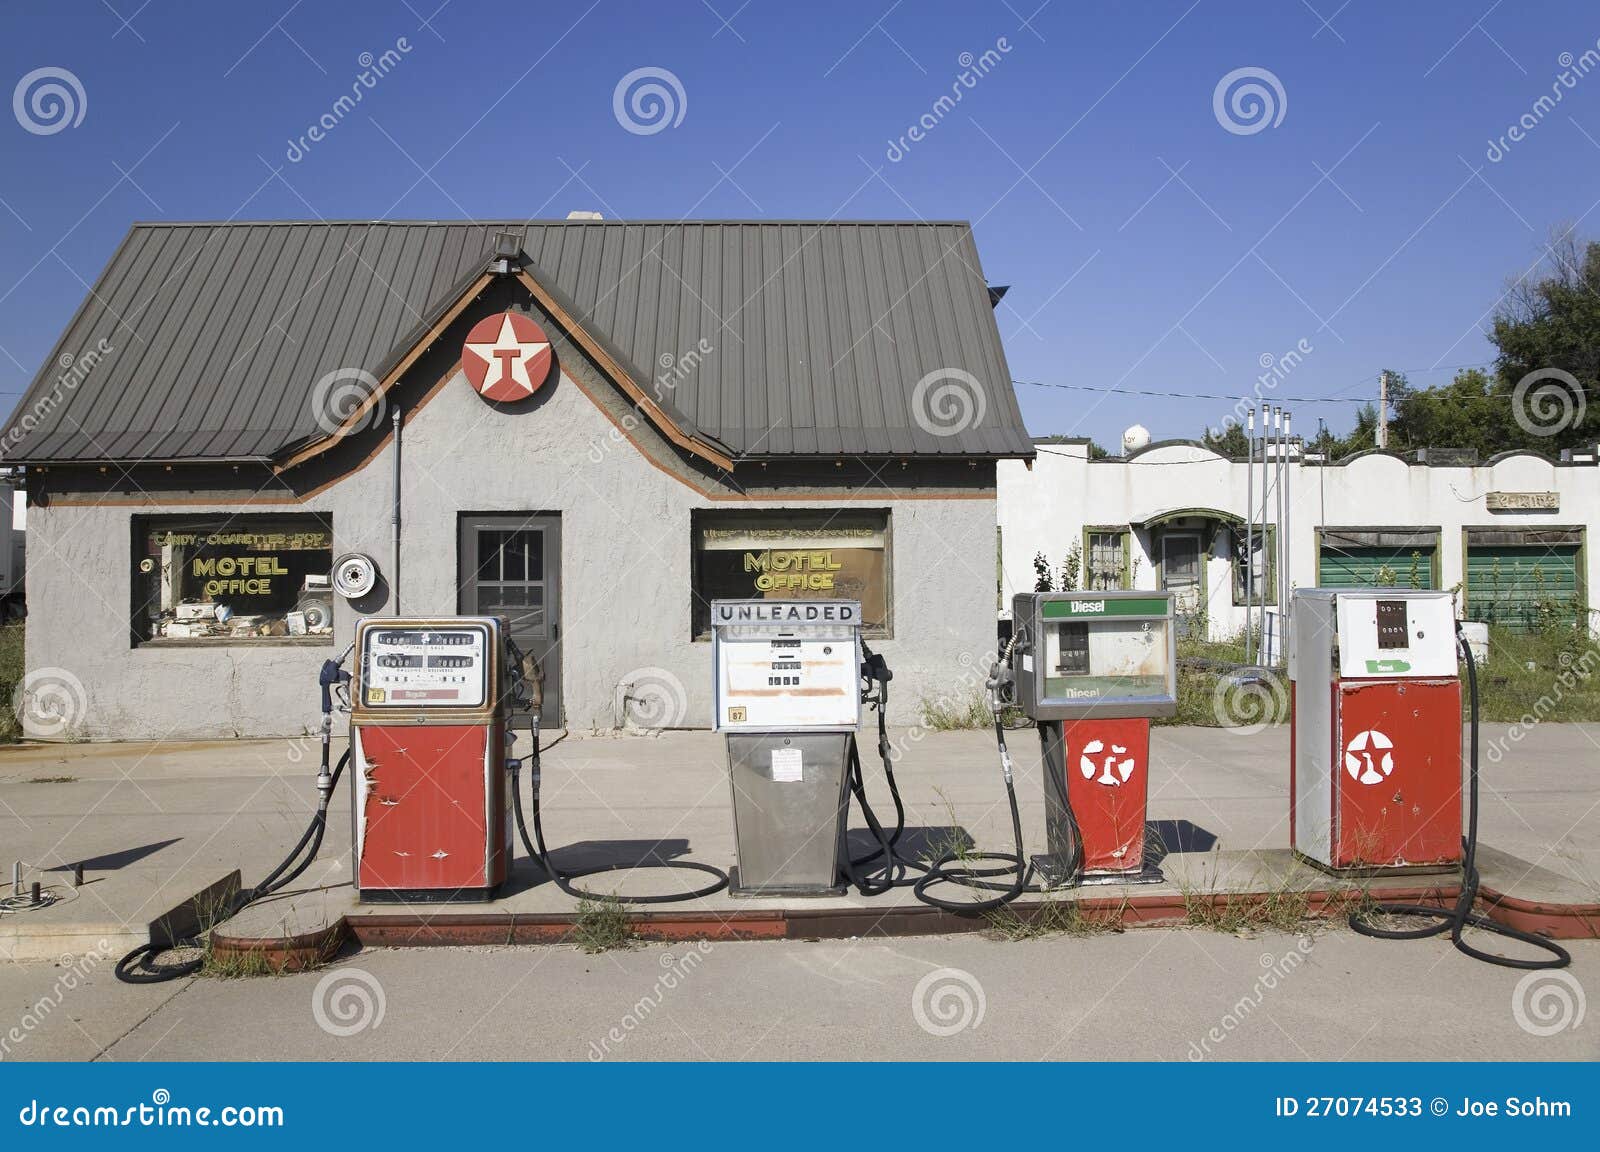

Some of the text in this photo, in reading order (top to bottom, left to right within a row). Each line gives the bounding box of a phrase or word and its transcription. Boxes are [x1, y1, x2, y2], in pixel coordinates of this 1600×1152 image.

[153, 534, 197, 546] CANDY
[207, 533, 286, 546] CIGARETTES
[293, 533, 325, 546] POP
[193, 556, 288, 577] MOTEL
[743, 552, 841, 573] MOTEL
[205, 578, 271, 595] OFFICE
[755, 573, 835, 592] OFFICE
[721, 606, 853, 621] UNLEADED
[1071, 600, 1105, 613] Diesel
[1066, 687, 1100, 699] Diesel
